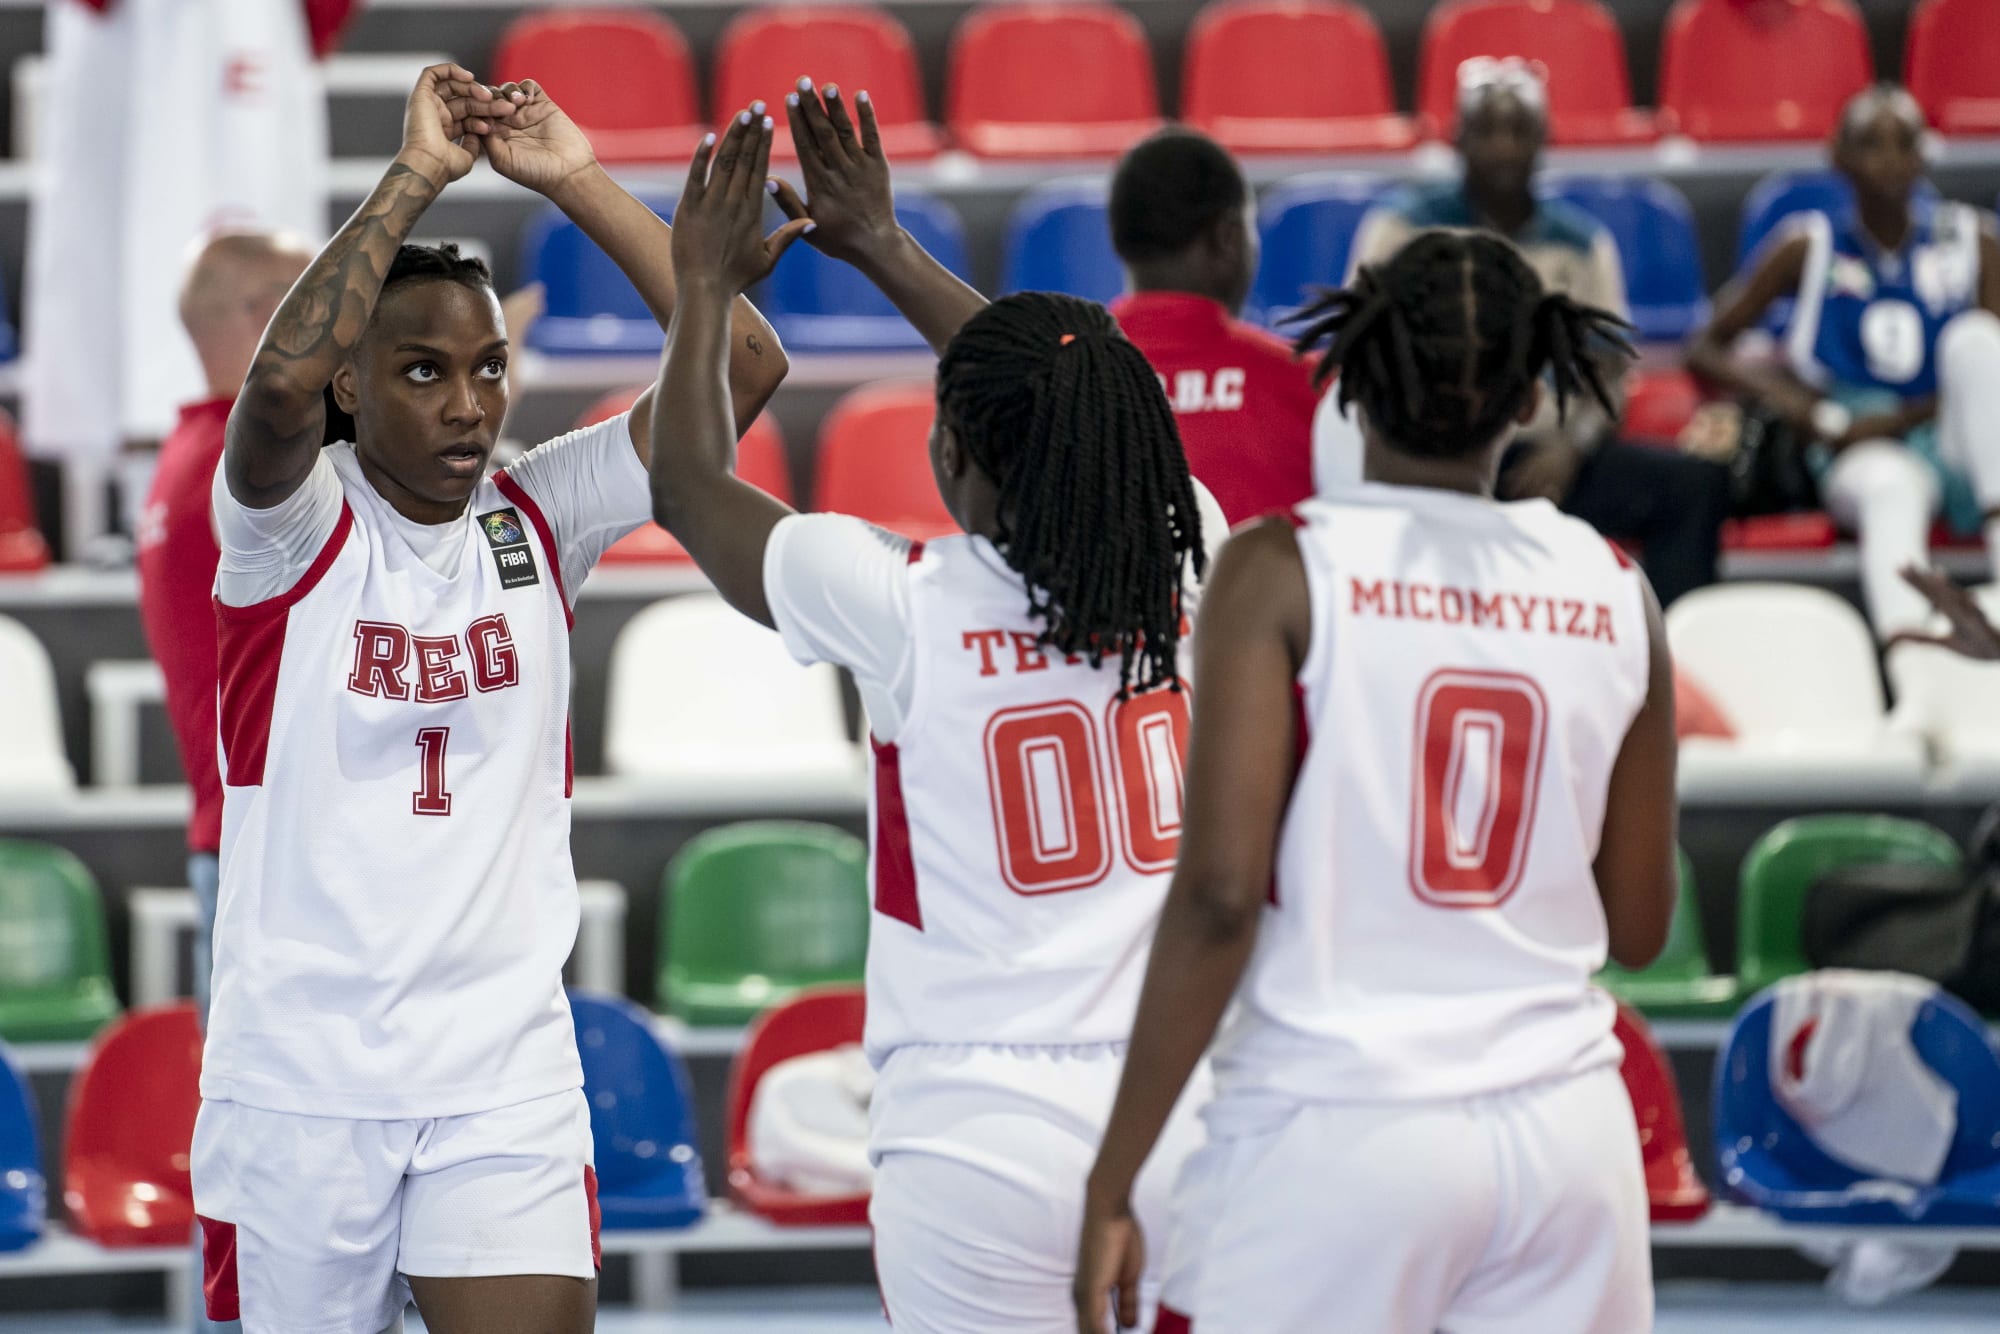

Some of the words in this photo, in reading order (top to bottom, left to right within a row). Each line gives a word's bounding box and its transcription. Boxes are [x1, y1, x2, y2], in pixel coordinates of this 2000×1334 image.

[500, 550, 529, 568] FIBA
[1350, 576, 1617, 645] MICOMYIZA
[347, 613, 519, 703] REG
[413, 726, 452, 816] 1
[984, 675, 1193, 897] 00
[1408, 667, 1549, 910] 0
